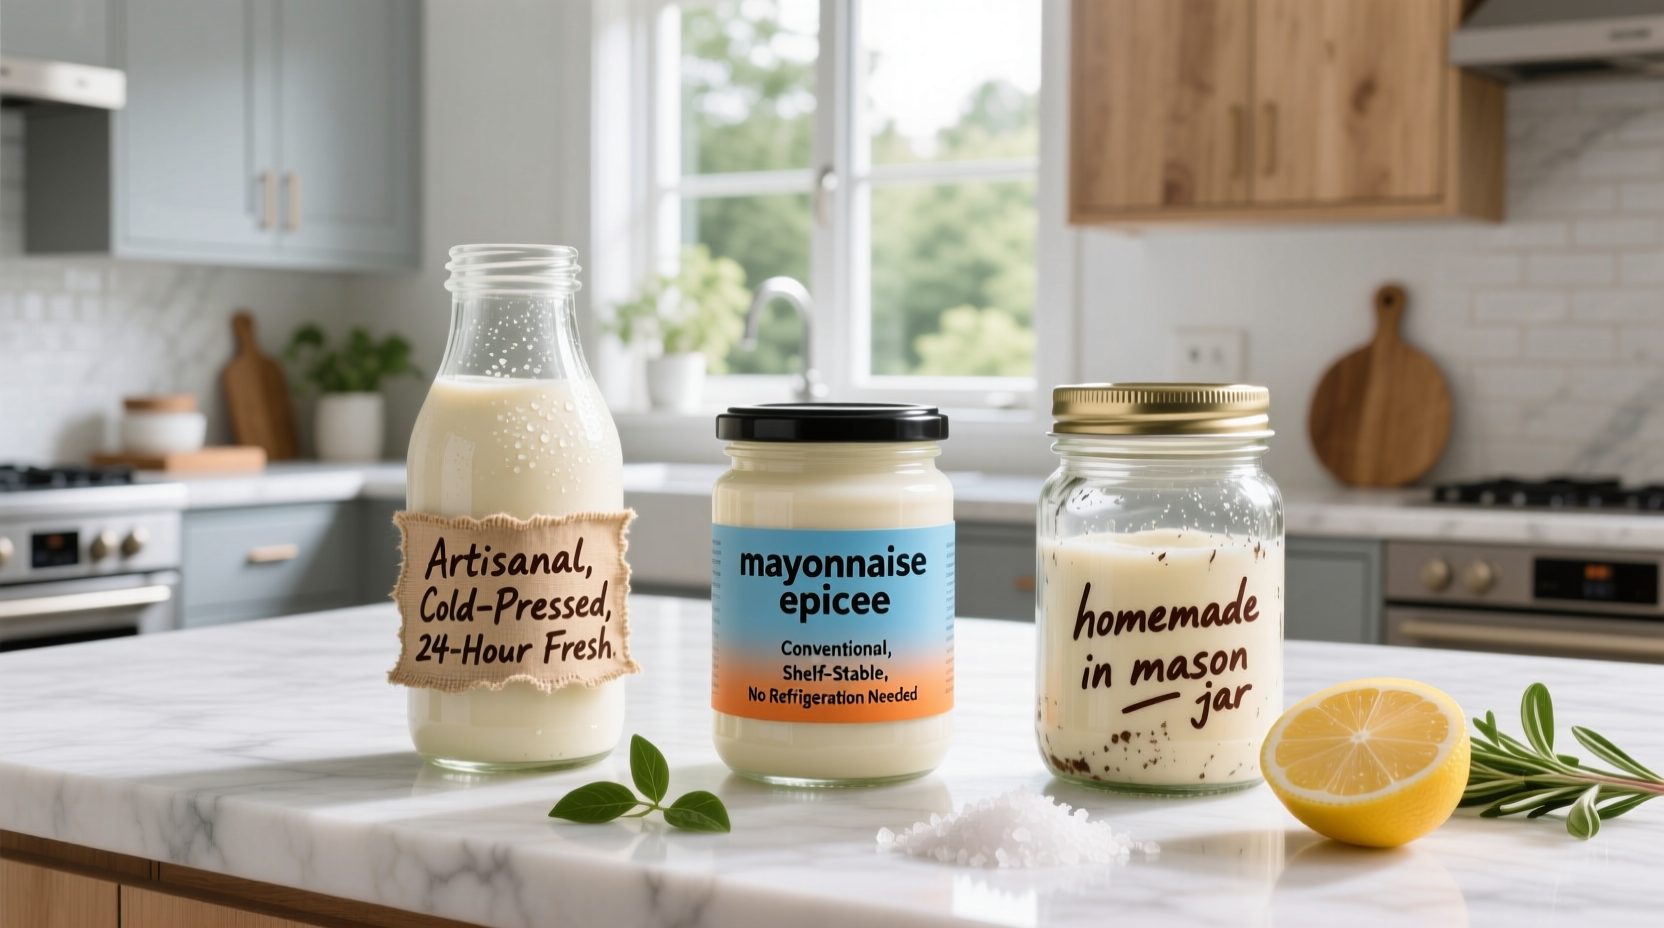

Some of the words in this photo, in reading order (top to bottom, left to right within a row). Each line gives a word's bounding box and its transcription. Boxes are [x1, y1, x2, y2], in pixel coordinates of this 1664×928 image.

[424, 536, 593, 580] Artisanal,
[740, 544, 927, 587] mayonnaise
[419, 580, 612, 626] Cold-Pressed,
[779, 582, 891, 624] epicee
[1072, 576, 1259, 642] homemade
[414, 632, 534, 666] 24-Hour
[780, 639, 892, 659] Conventional,
[1081, 653, 1112, 690] in
[1129, 647, 1248, 687] mason
[748, 686, 766, 703] No
[868, 685, 918, 704] Needed
[782, 664, 889, 682] Shelf-Stable,
[1190, 679, 1253, 730] jar
